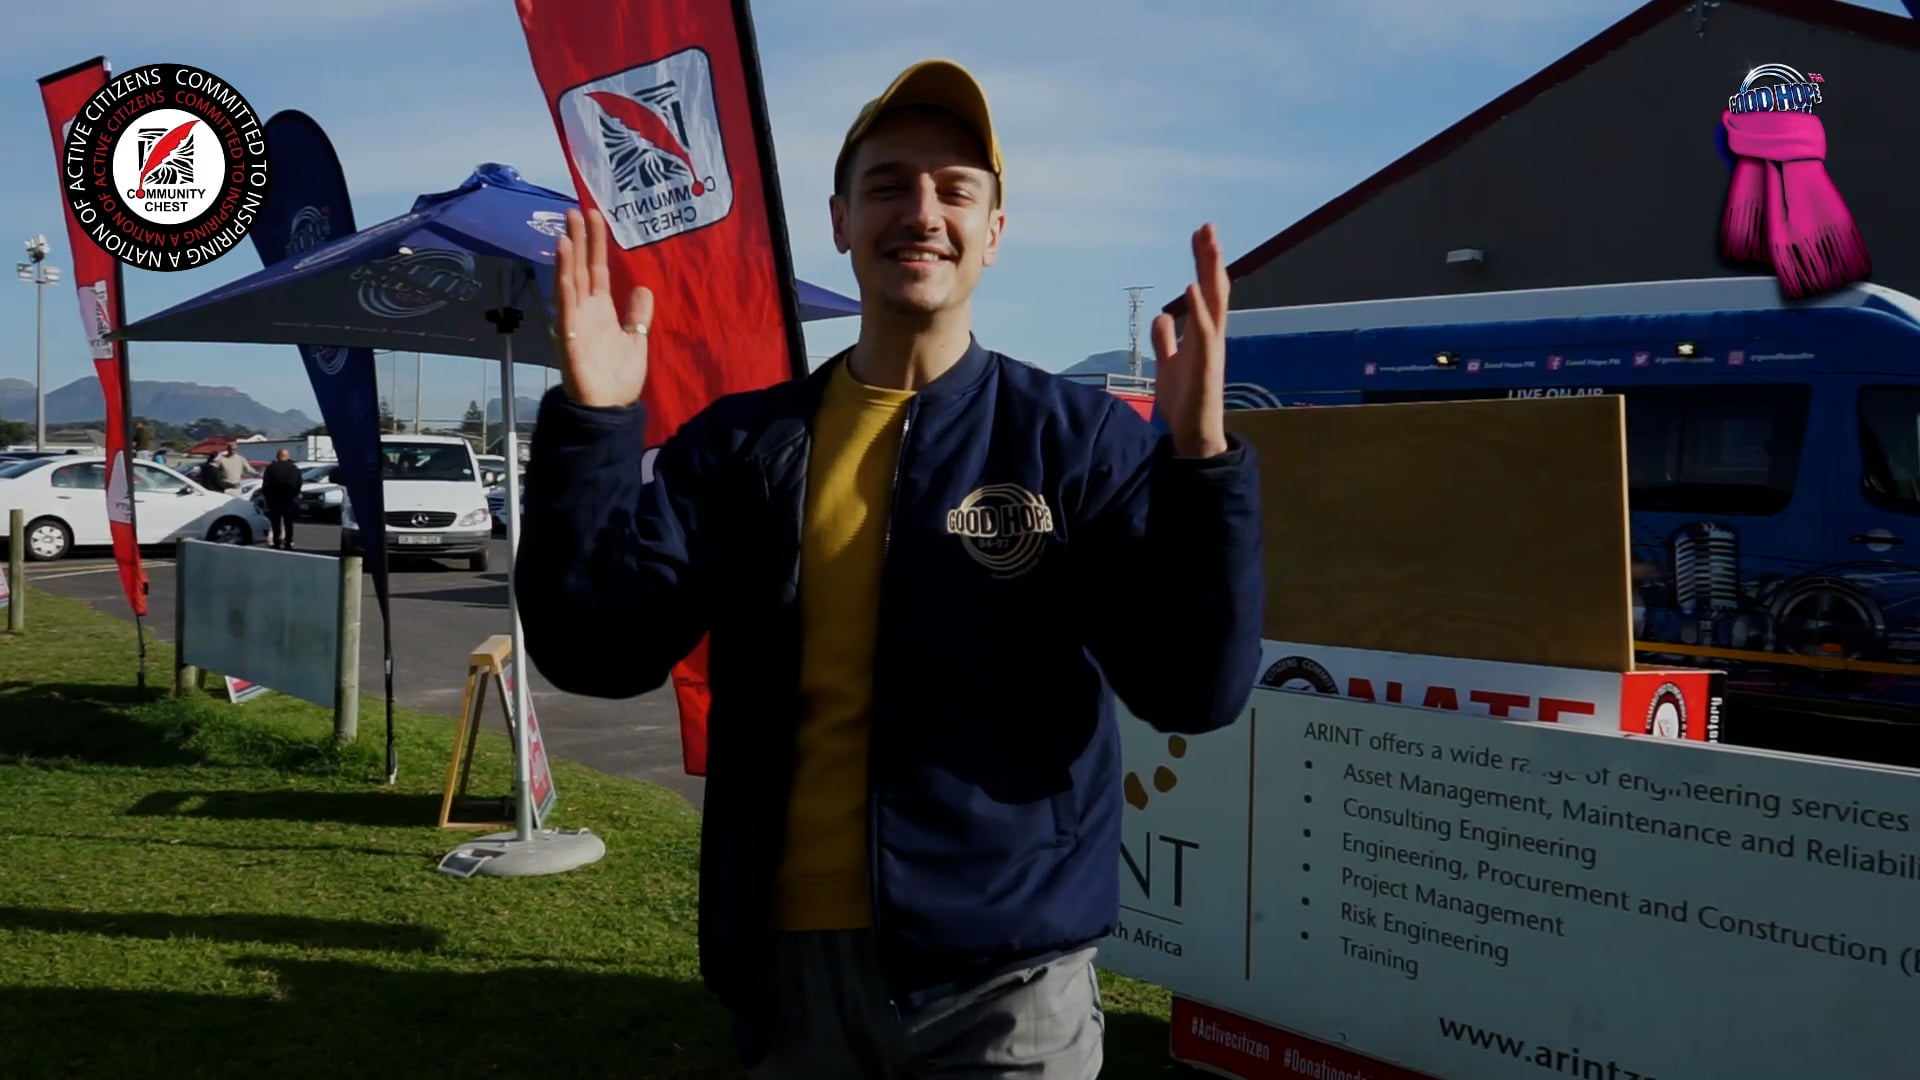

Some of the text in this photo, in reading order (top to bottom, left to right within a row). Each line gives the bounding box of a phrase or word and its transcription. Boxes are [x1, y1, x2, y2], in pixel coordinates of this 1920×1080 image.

[1507, 388, 1544, 400] LIVE
[1545, 387, 1572, 399] ON
[947, 503, 1053, 538] GOOD HOPE
[1303, 721, 1365, 747] ARINT
[1369, 732, 1425, 758] offers
[1431, 745, 1443, 760] a
[1450, 747, 1504, 770] wide
[1618, 771, 1781, 819] engneering
[1792, 797, 1911, 833] services
[1343, 763, 1393, 788] Asset
[1399, 771, 1553, 821] Management,
[1562, 798, 1732, 848] Maintenance
[1741, 833, 1795, 858] and
[1343, 797, 1596, 871] Consulting Engineering
[1341, 866, 1566, 937] Project Management
[1342, 832, 1469, 881] Engineering,
[1477, 860, 1631, 912] Procurement
[1638, 898, 1688, 923] and
[1698, 906, 1887, 966] Construction
[1133, 928, 1183, 957] Africa
[1339, 936, 1419, 981] Training
[1341, 902, 1510, 968] Risk Engineering
[1191, 1015, 1270, 1064] #Activecitizen
